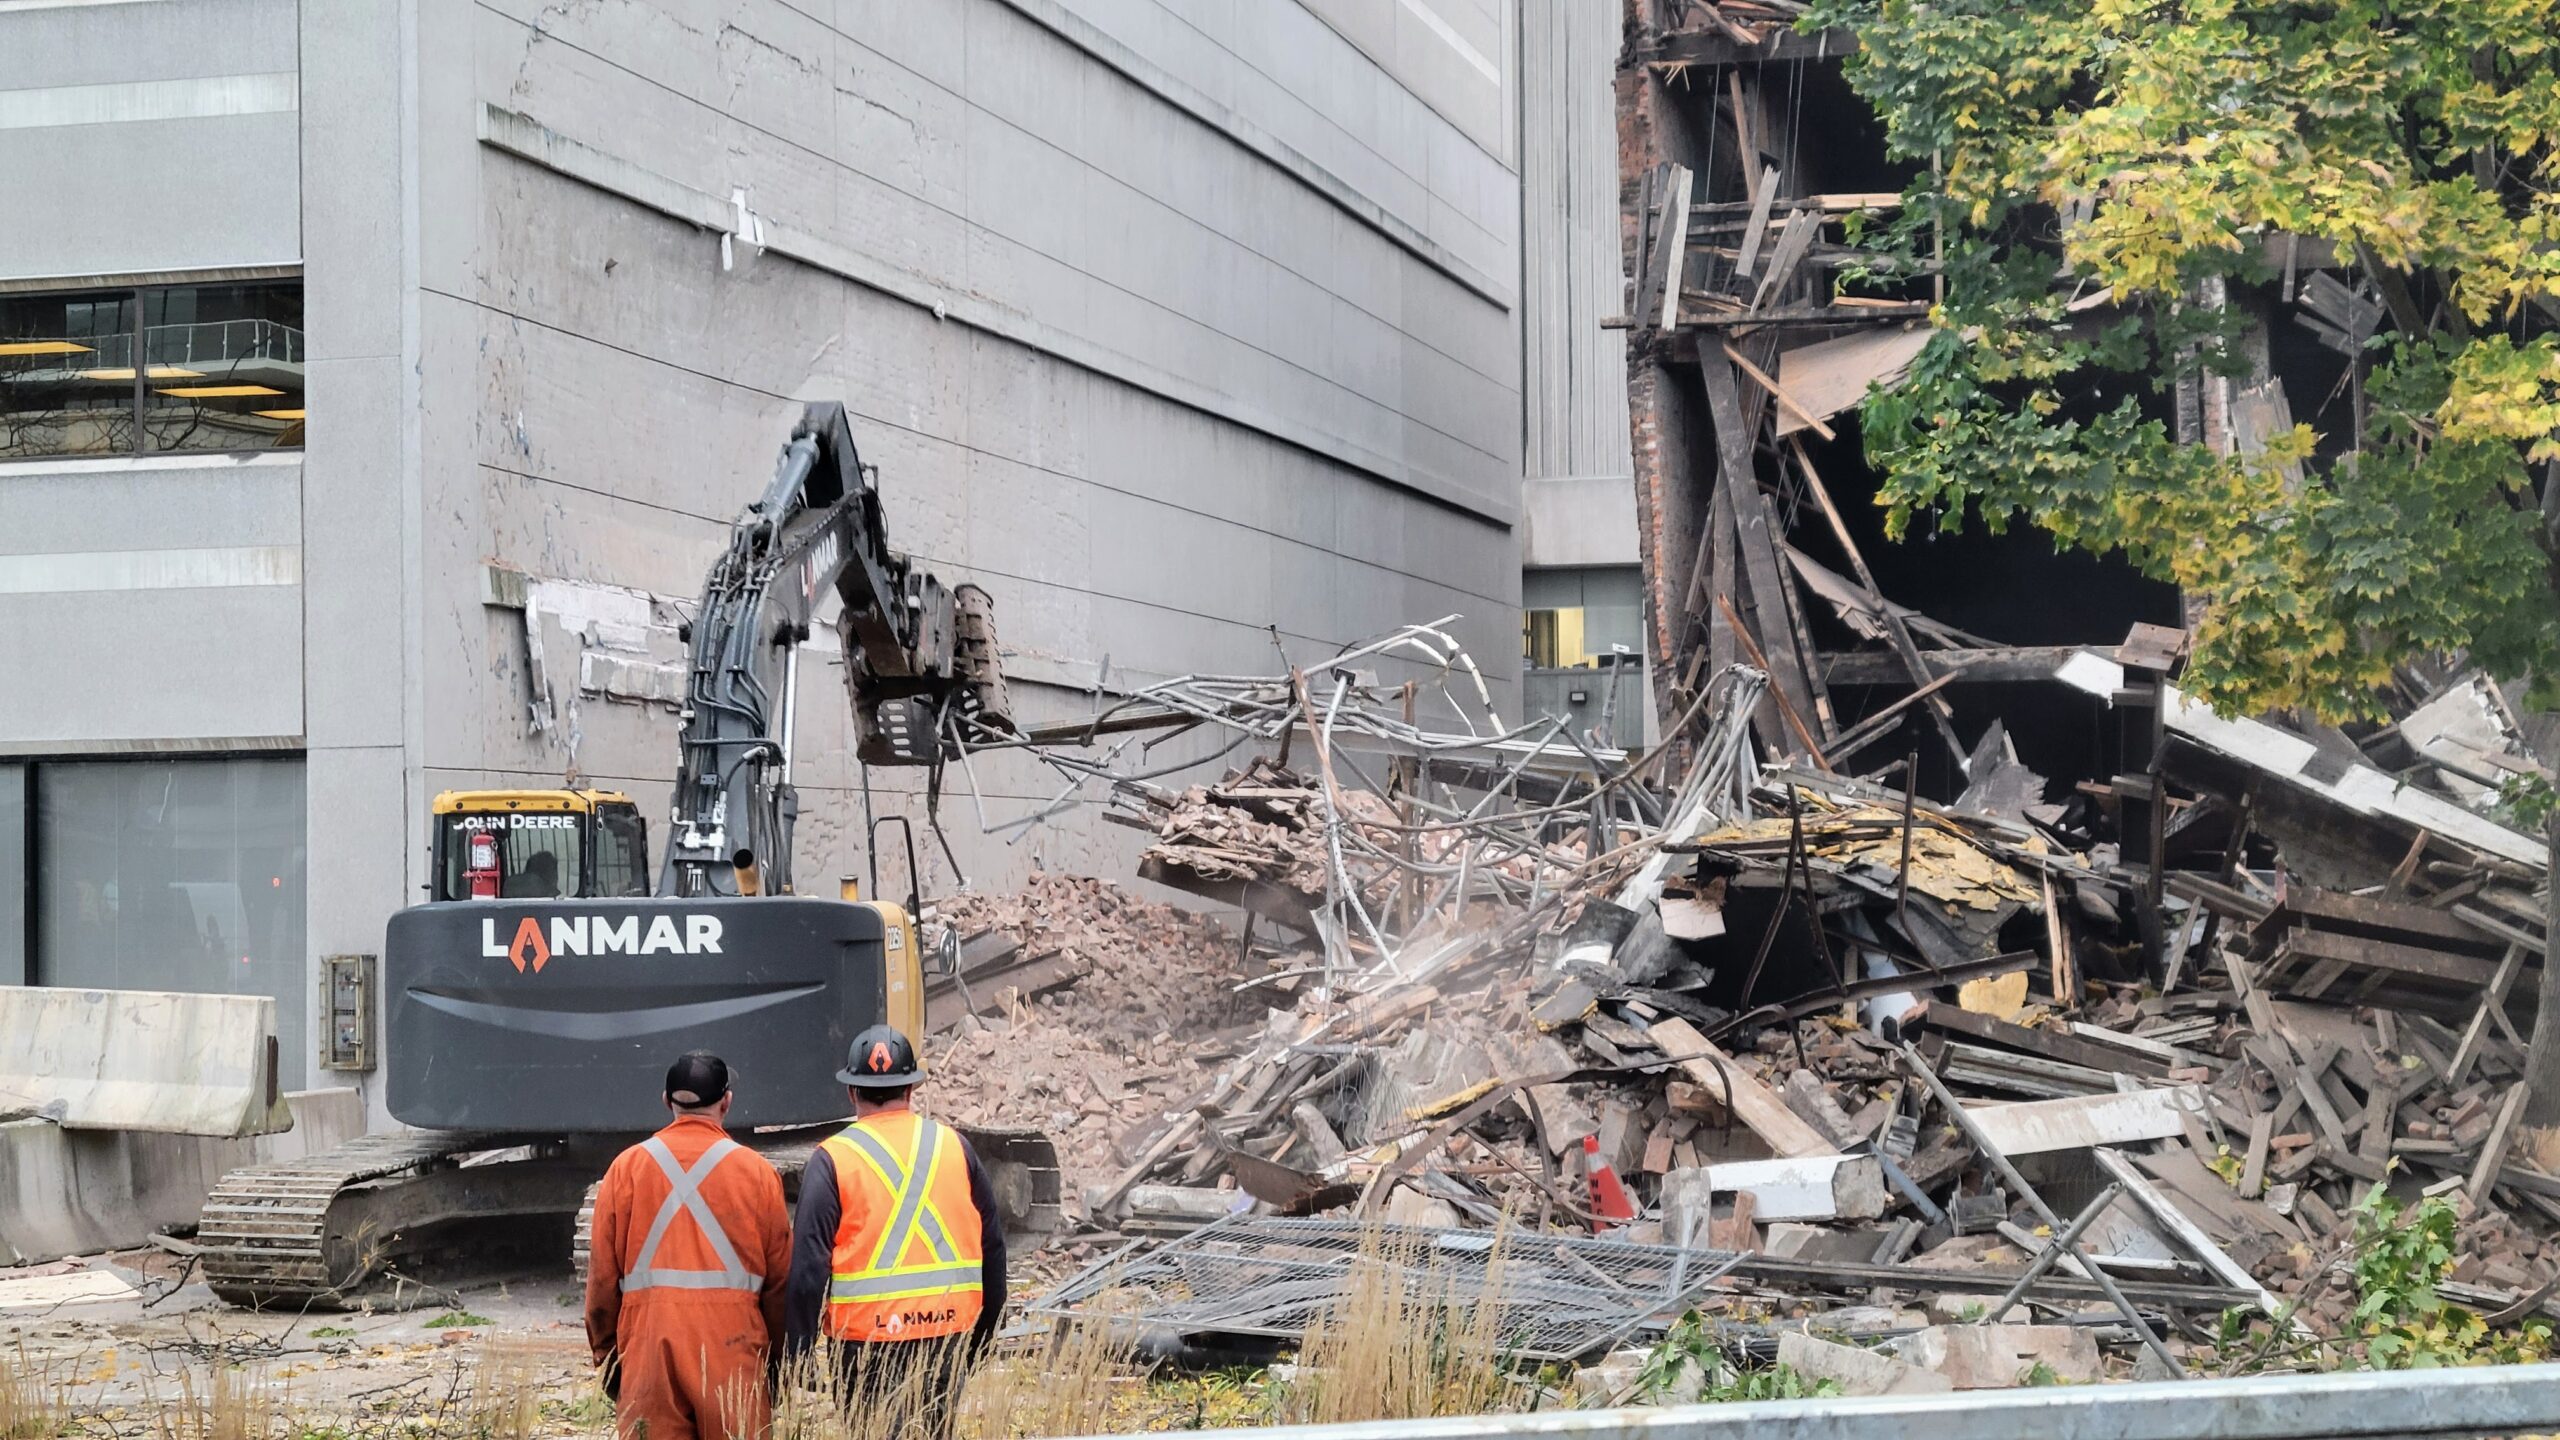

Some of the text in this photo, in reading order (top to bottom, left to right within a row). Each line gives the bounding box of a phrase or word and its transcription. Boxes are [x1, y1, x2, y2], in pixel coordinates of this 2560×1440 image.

[510, 814, 575, 829] DEERE
[482, 914, 723, 974] LANMAR
[875, 1308, 956, 1335] LANMAR
